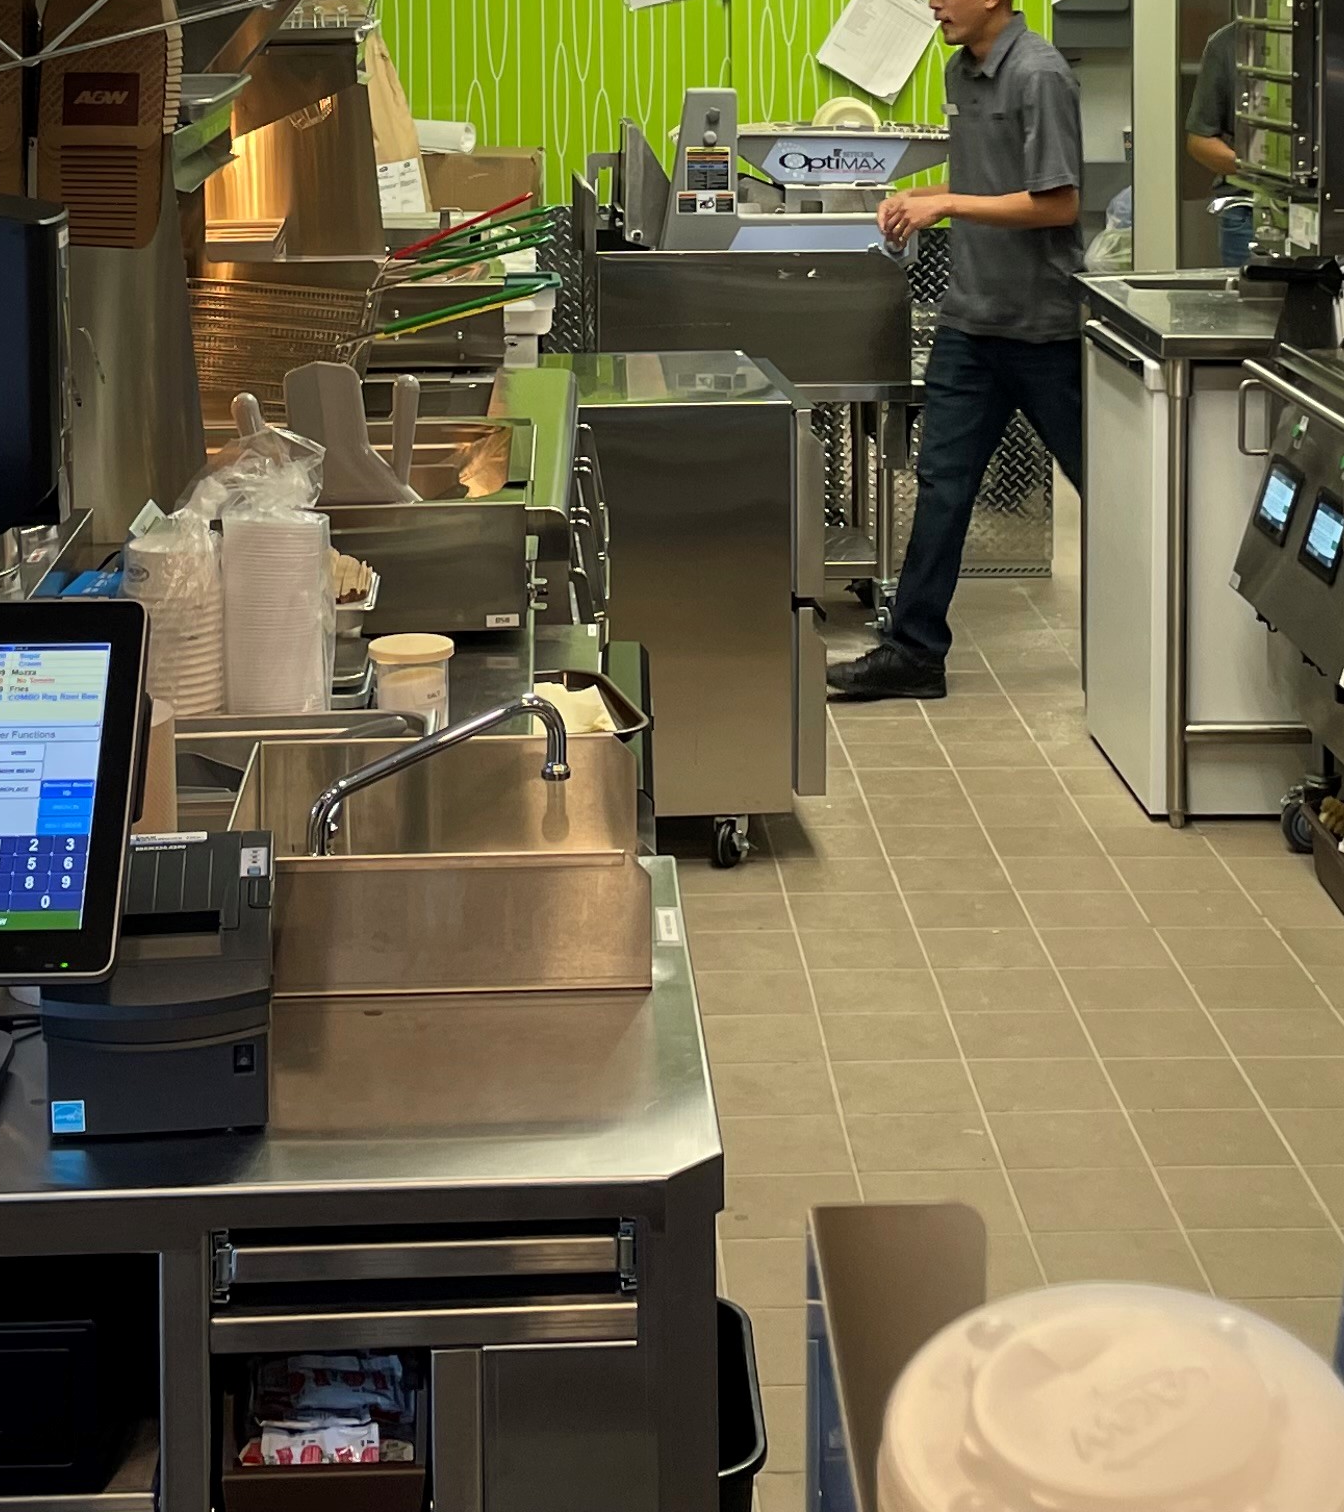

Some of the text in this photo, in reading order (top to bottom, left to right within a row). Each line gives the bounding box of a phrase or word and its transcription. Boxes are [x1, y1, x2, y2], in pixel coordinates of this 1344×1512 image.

[11, 730, 56, 739] Functions
[29, 839, 39, 852] 2
[65, 838, 75, 851] 3
[27, 857, 37, 870] 5
[63, 857, 73, 870] 6
[24, 876, 35, 889] 8
[61, 876, 71, 888] 9
[40, 895, 50, 908] 0
